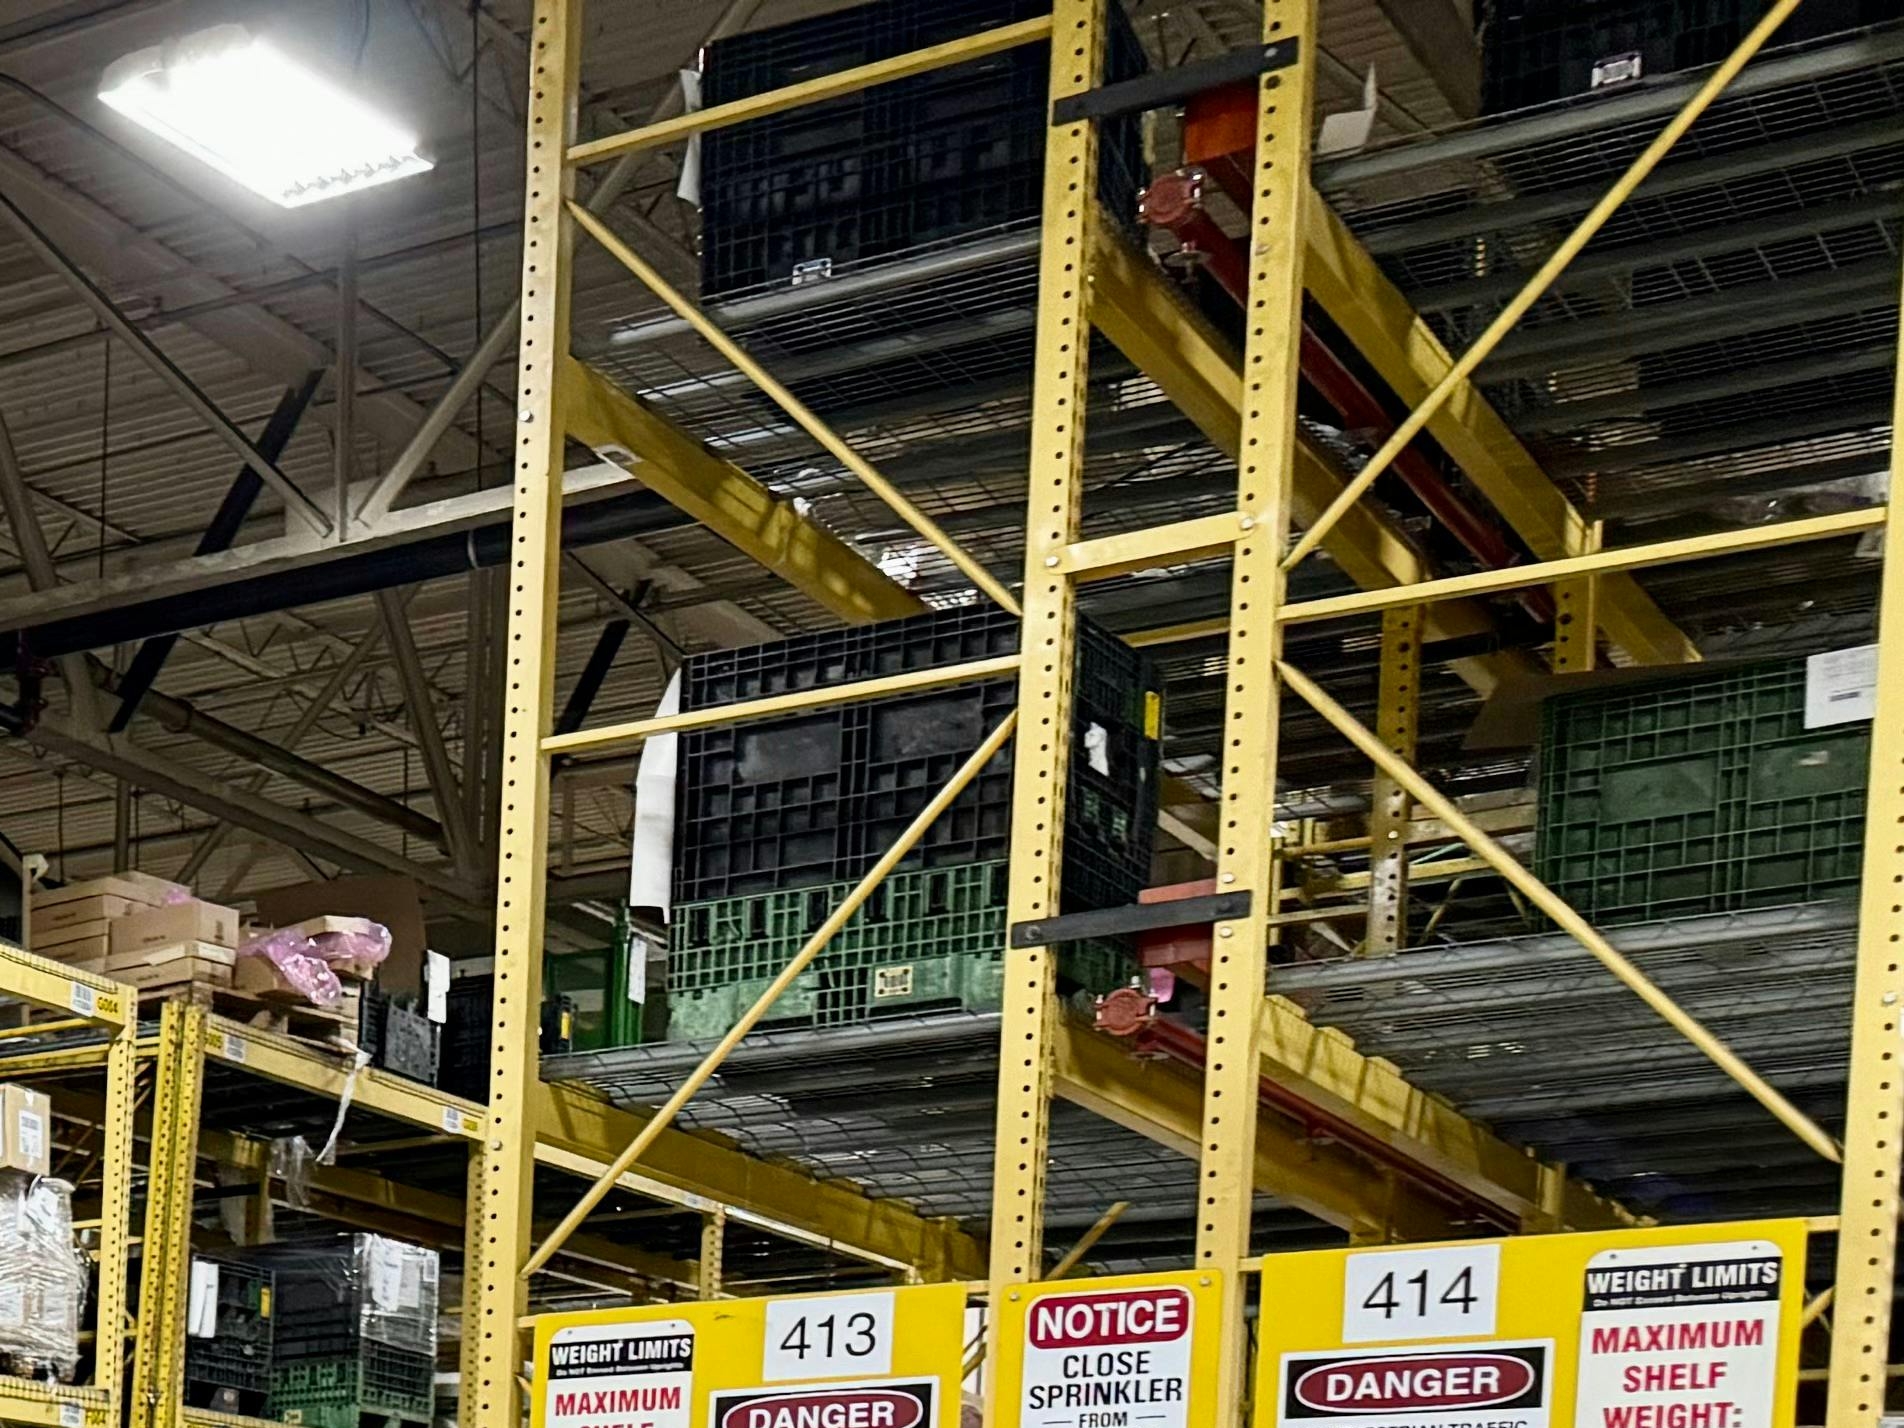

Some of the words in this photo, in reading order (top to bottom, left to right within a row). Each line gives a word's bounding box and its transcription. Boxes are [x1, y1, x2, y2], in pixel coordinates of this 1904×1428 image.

[1362, 1266, 1478, 1319] 414
[1587, 1269, 1687, 1294] WEIGHT
[1692, 1261, 1778, 1289] LIMITS
[1036, 1297, 1181, 1341] NOTICE
[551, 1343, 623, 1365] WEIGHT
[628, 1338, 692, 1361] LIMITS
[780, 1312, 876, 1360] 413
[1592, 1318, 1765, 1355] MAXIMUM
[1063, 1350, 1151, 1379] CLOSE
[1622, 1361, 1728, 1393] SHELF
[1029, 1377, 1183, 1410] SPRINKLER
[1326, 1366, 1501, 1402] DANGER
[555, 1386, 681, 1417] MAXIMUM
[1079, 1412, 1128, 1428] FROM
